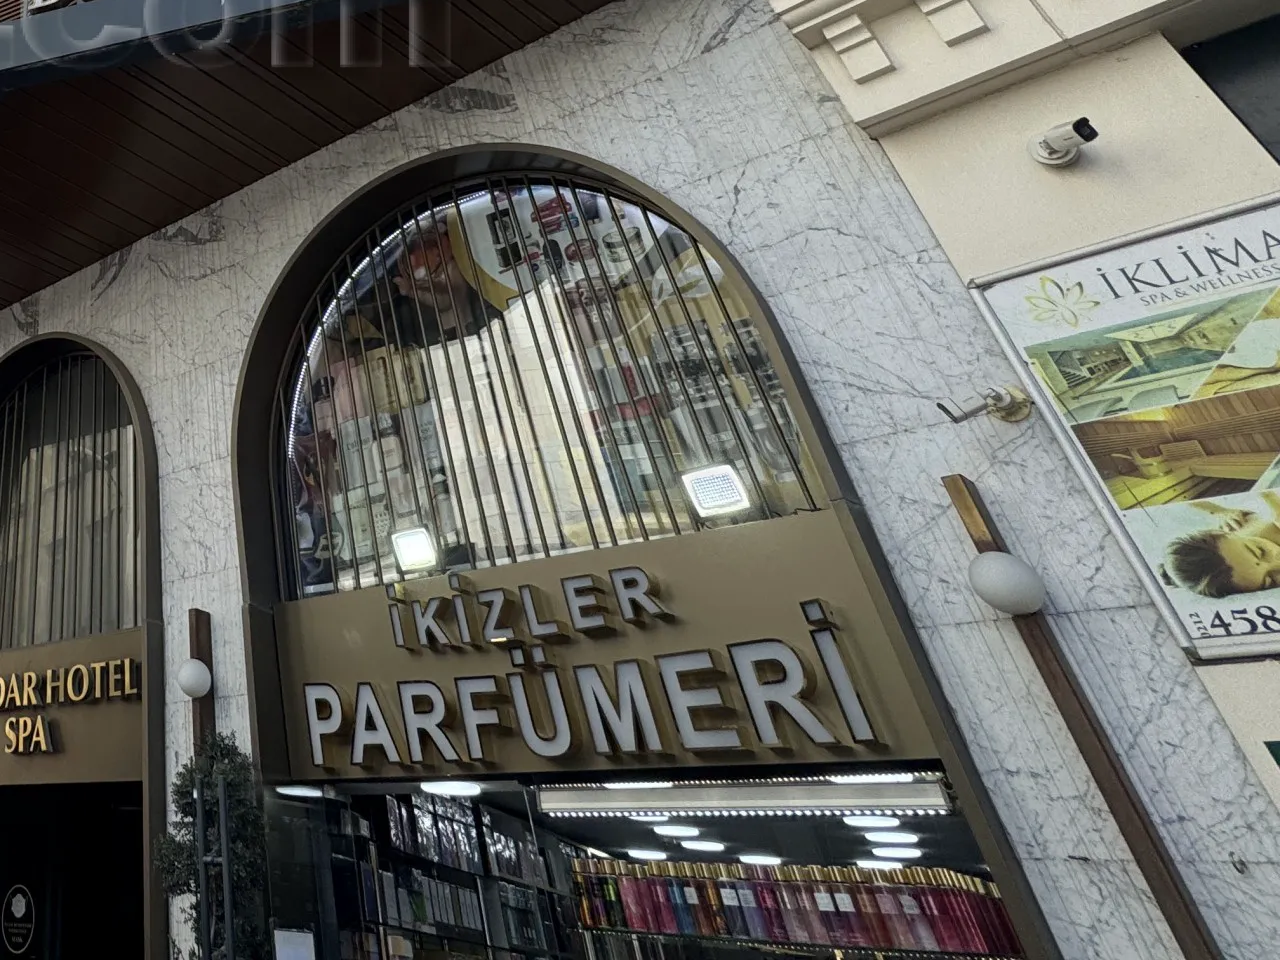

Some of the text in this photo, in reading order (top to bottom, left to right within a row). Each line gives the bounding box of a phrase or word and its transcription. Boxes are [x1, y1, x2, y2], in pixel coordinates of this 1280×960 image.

[1140, 291, 1171, 307] SPA
[1174, 287, 1189, 299] &
[385, 565, 670, 651] İKİZLER
[1210, 605, 1280, 637] 458
[45, 657, 138, 704] HOTEL
[303, 598, 884, 768] PARFÜMERİ
[4, 714, 50, 754] SPA
